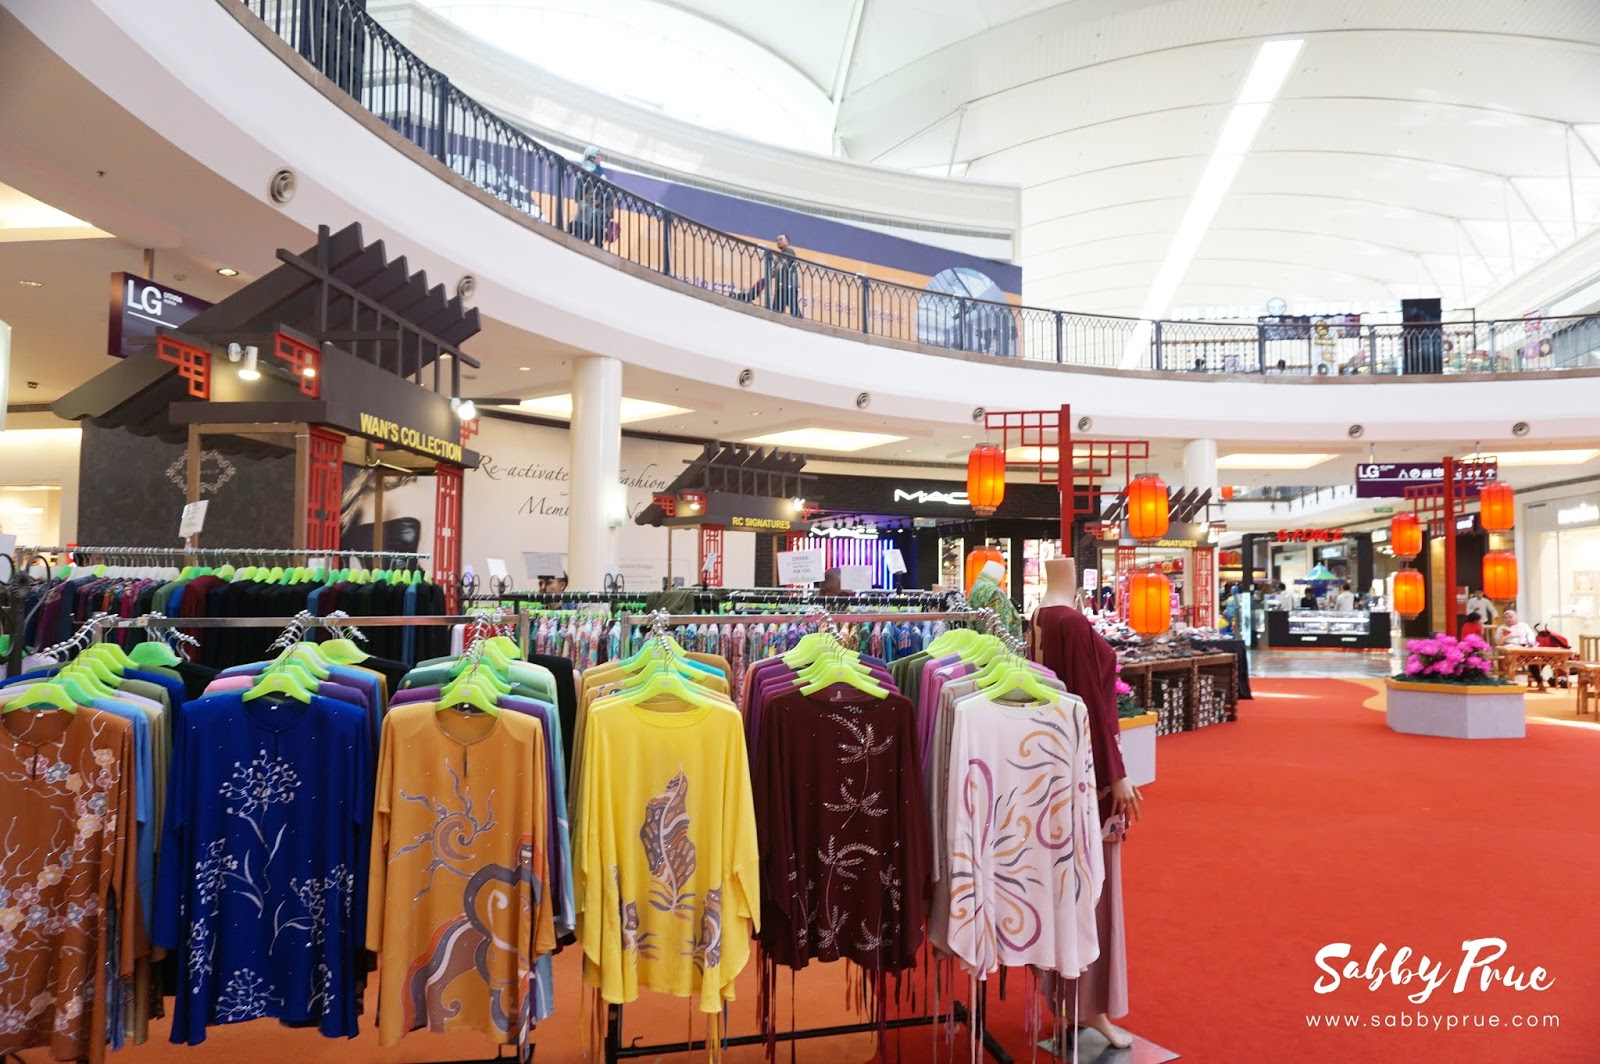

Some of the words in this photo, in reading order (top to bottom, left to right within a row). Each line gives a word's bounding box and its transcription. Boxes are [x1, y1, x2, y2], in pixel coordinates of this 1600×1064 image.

[127, 279, 162, 316] LG
[360, 412, 399, 442] WAN'S
[400, 426, 462, 462] COLLECTION
[474, 455, 569, 481] Re-activate
[620, 463, 669, 490] ashion
[1358, 465, 1380, 479] LG
[894, 488, 971, 505] MAC
[732, 516, 744, 527] RC
[744, 517, 791, 530] SIGNATURES
[1155, 539, 1198, 548] GNATURES
